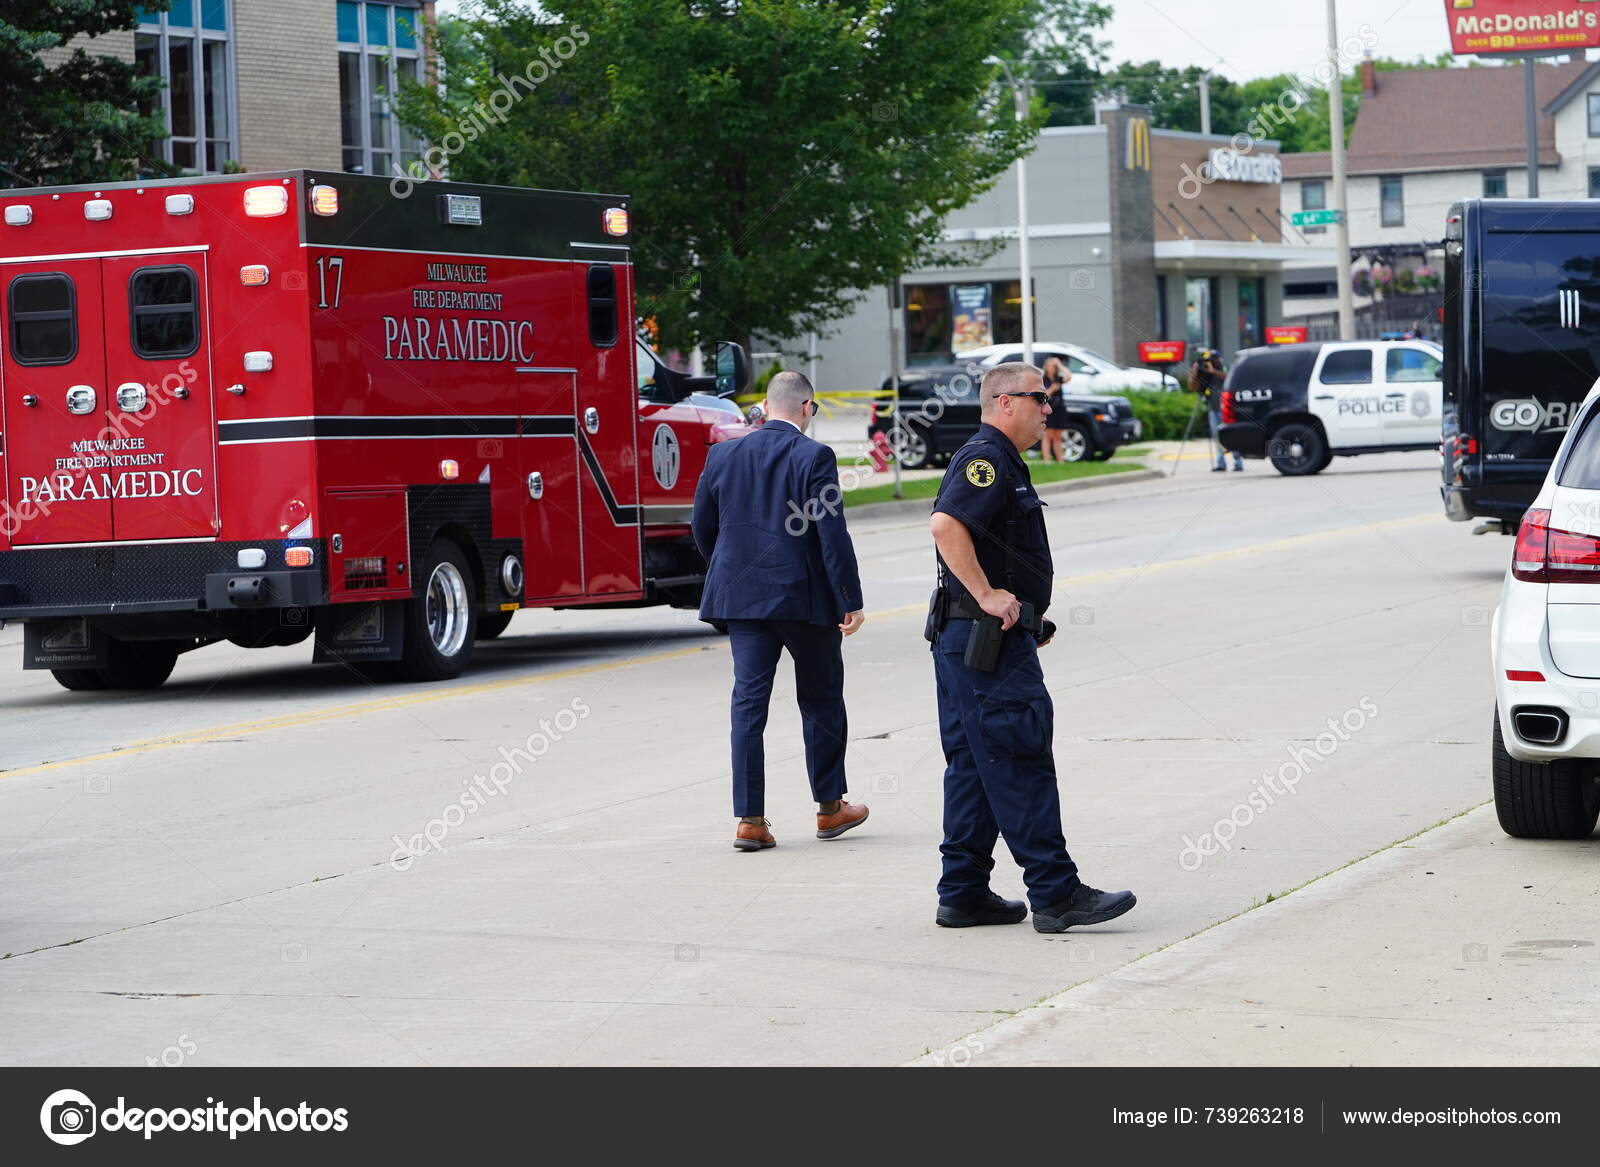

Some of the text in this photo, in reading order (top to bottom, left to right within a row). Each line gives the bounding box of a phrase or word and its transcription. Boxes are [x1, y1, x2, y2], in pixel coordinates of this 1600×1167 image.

[1456, 10, 1597, 34] McDonald's
[316, 256, 343, 309] 17
[426, 262, 487, 283] MILWAUKEE
[412, 290, 503, 311] FIRE DEPARTMENT
[382, 316, 535, 363] PARAMEDIC
[1338, 400, 1405, 415] POLICE
[72, 438, 145, 452] MILWAUKEE
[55, 453, 164, 470] FIRE DEPARTMENT
[20, 468, 203, 503] PARAMEDIC
